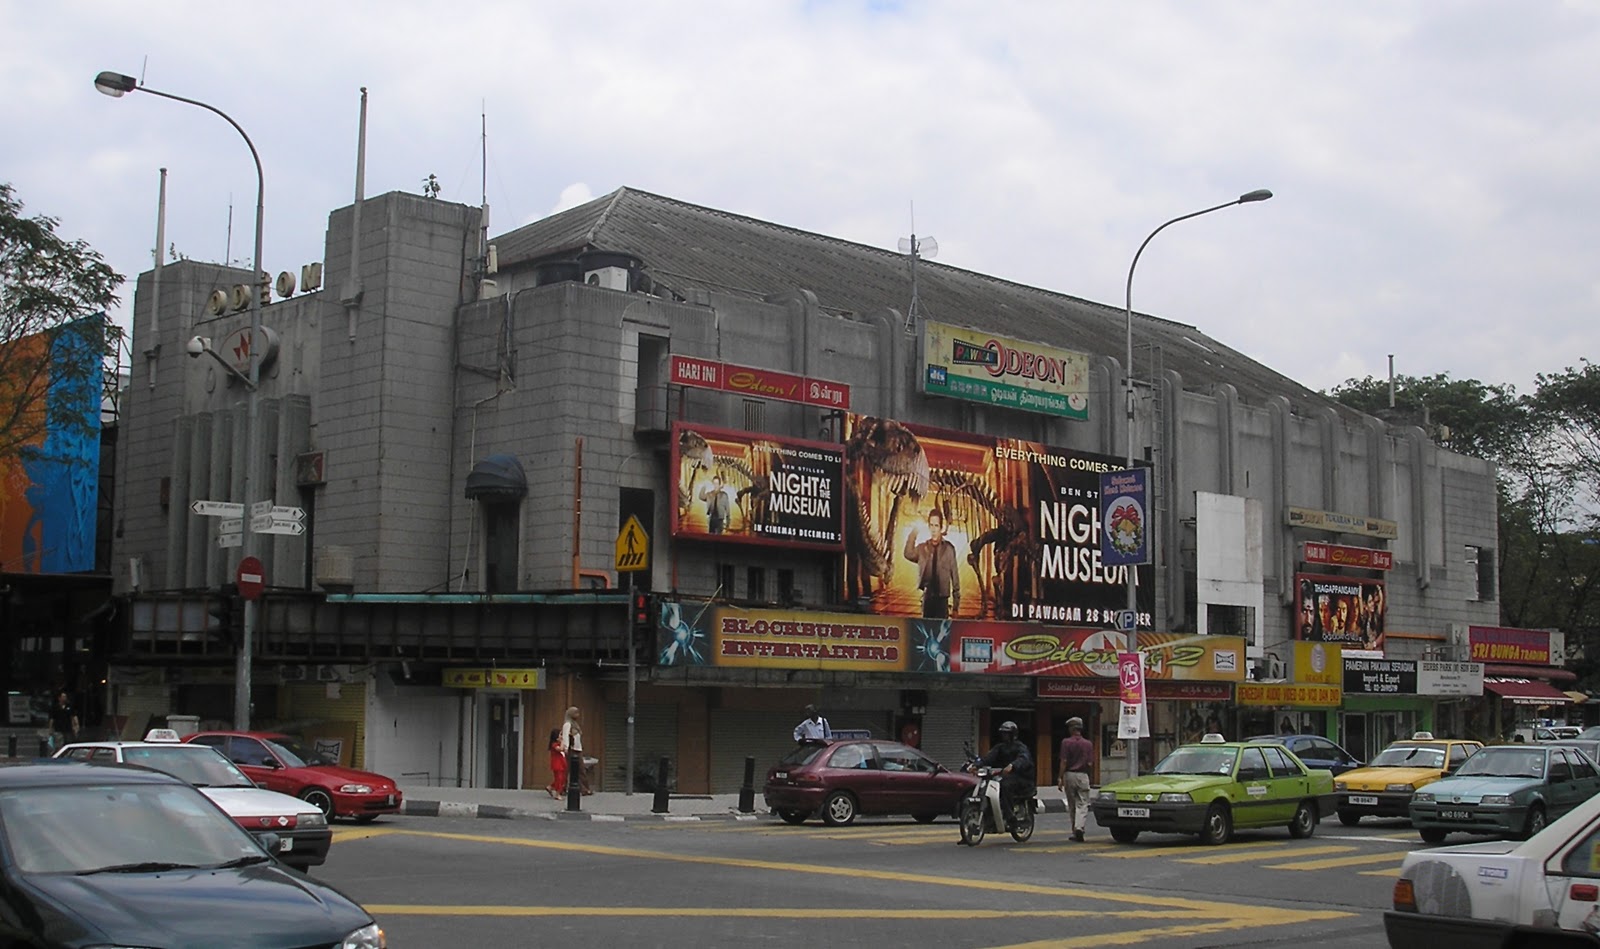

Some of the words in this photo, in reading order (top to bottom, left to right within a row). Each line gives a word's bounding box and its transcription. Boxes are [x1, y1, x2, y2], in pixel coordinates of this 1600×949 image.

[678, 362, 700, 379] HARI
[702, 366, 716, 382] INI
[983, 339, 1067, 384] ODEON
[729, 372, 785, 396] Odeon
[798, 451, 823, 461] COMES
[824, 455, 834, 463] TO
[995, 447, 1066, 468] EVERYTHING
[1070, 458, 1108, 473] COMES
[769, 471, 819, 497] NIGHT
[819, 478, 831, 489] AT
[1061, 487, 1081, 497] BEN
[769, 492, 831, 518] MUSEUM
[753, 523, 762, 532] IN
[765, 524, 796, 536] CINEMAS
[799, 529, 835, 540] DECEMBER
[1040, 500, 1101, 544] NIGH
[1012, 603, 1024, 618] DI
[1028, 604, 1081, 621] PAWAGAM
[1086, 610, 1099, 622] 28
[1124, 612, 1133, 628] P
[722, 617, 900, 641] BLOCKBUSTERS
[722, 640, 898, 662] ENTERTAINERS
[1004, 634, 1120, 666] Odeon
[1166, 645, 1204, 667] 2
[1472, 642, 1489, 659] SRI
[1490, 643, 1520, 659] BUNGA
[1520, 649, 1548, 661] TRADING
[1047, 683, 1073, 692] Selamat
[1074, 684, 1096, 694] Datang
